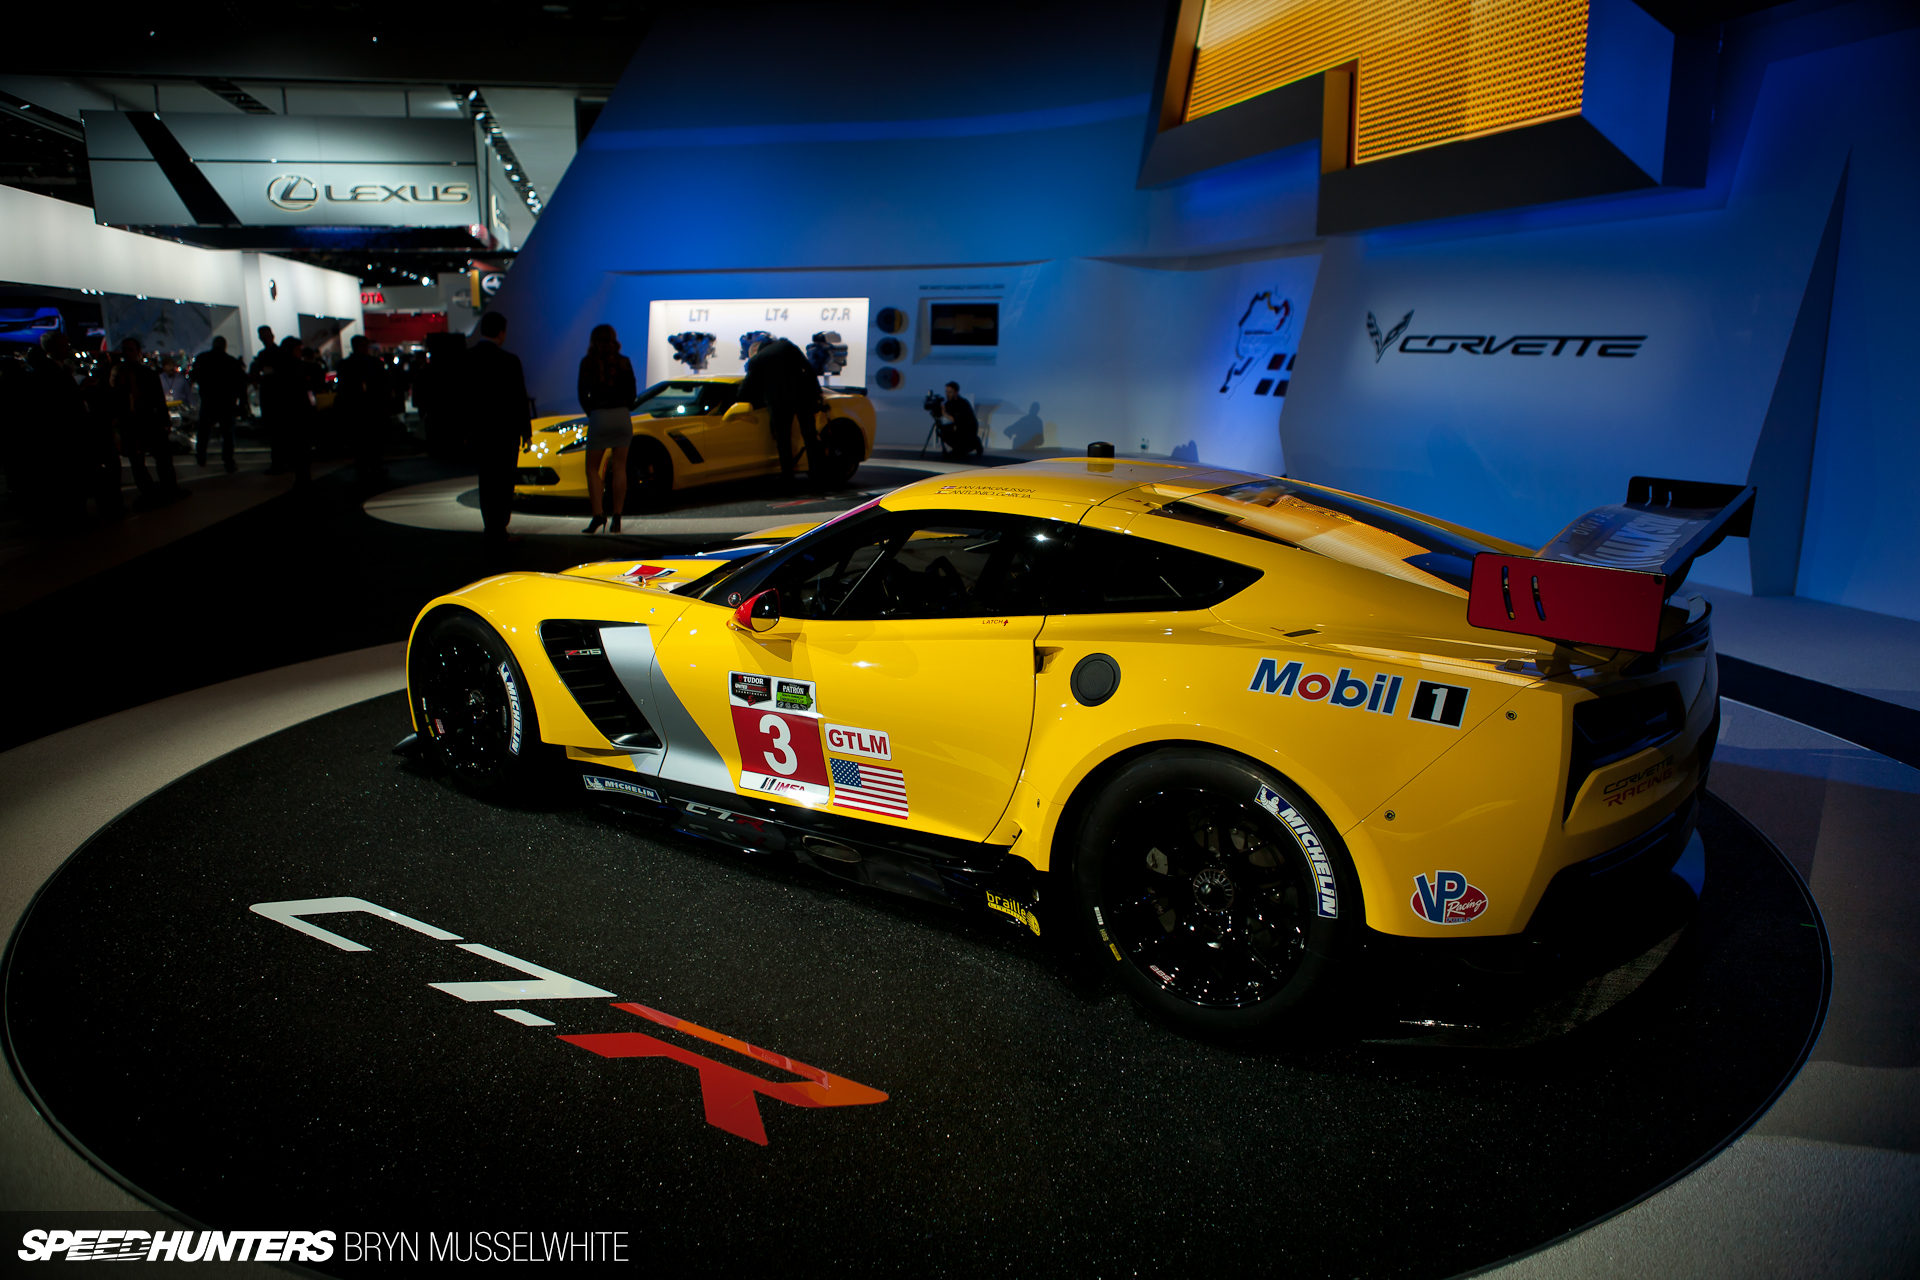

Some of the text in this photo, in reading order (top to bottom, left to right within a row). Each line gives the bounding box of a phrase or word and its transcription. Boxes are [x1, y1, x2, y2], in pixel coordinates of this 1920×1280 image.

[323, 183, 472, 204] LEXUS
[360, 292, 385, 304] OTA
[689, 308, 710, 322] LT1
[765, 308, 789, 321] LT4
[821, 307, 851, 321] C7.R
[1398, 335, 1649, 358] CORVETTE
[743, 675, 764, 684] TUDOR
[1247, 657, 1449, 721] Mobil 1
[506, 681, 521, 753] MICHELIN
[759, 714, 798, 775] 3
[828, 729, 889, 755] GTLM
[1603, 755, 1674, 794] CORVETTE
[604, 779, 655, 798] MICHELIN
[1602, 767, 1673, 807] RACING
[1279, 807, 1336, 915] MICHELIN
[986, 890, 1027, 917] braille
[1413, 870, 1467, 924] VP
[1447, 898, 1487, 917] Racing
